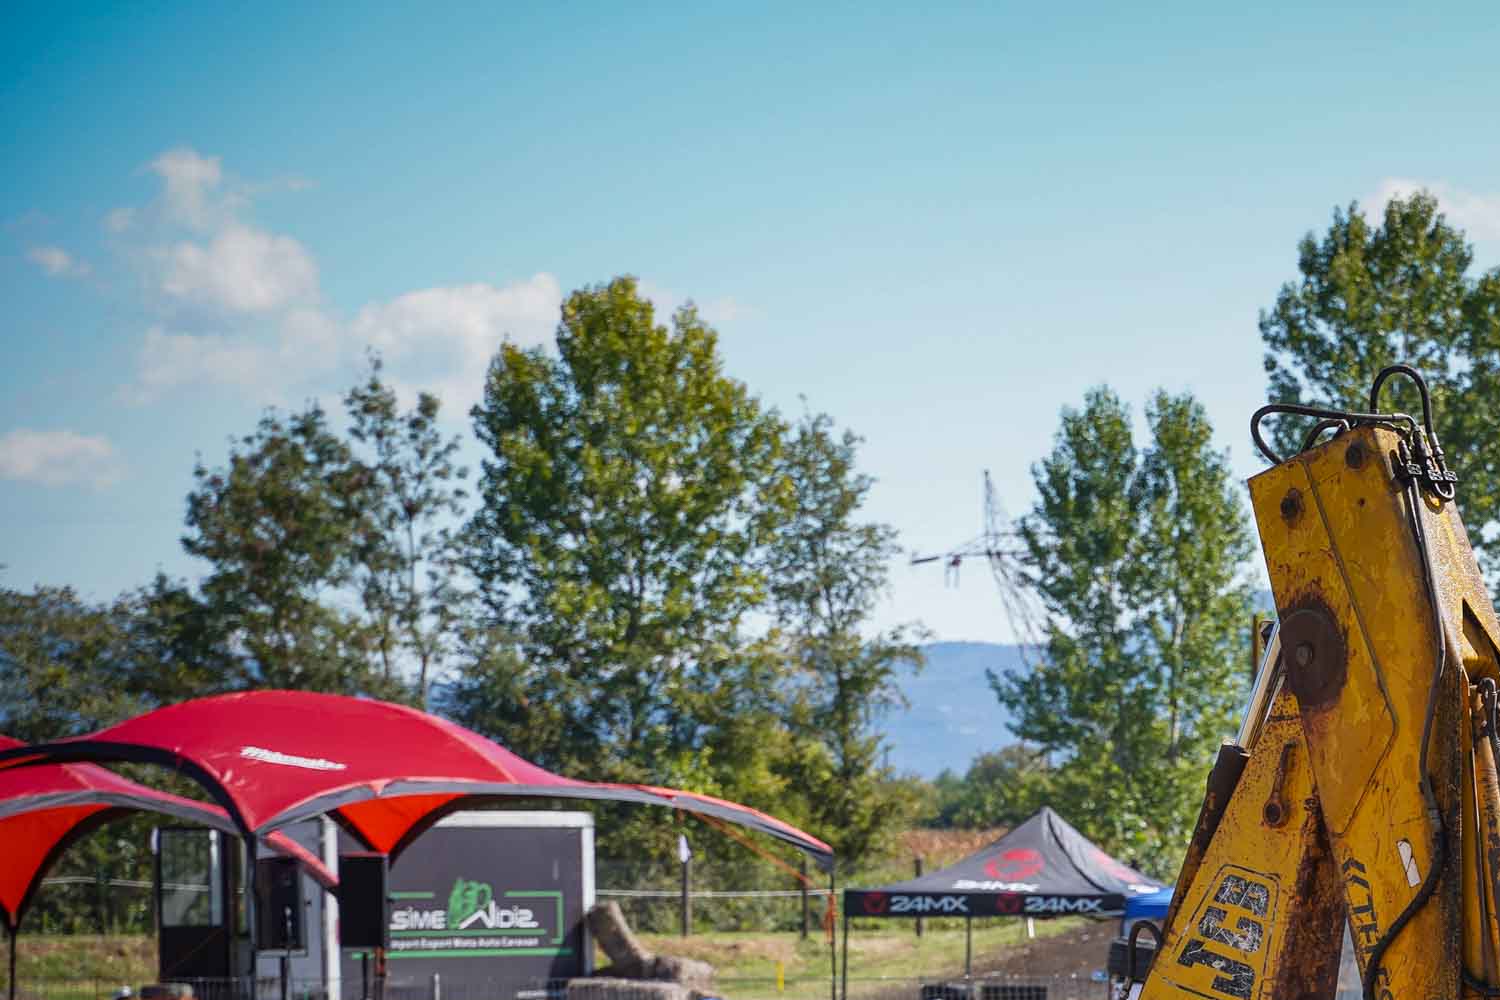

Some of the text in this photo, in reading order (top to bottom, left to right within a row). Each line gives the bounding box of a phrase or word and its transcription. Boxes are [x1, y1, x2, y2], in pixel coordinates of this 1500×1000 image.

[889, 895, 1104, 912] 24MX 24MX
[1177, 874, 1269, 1000] JCB
